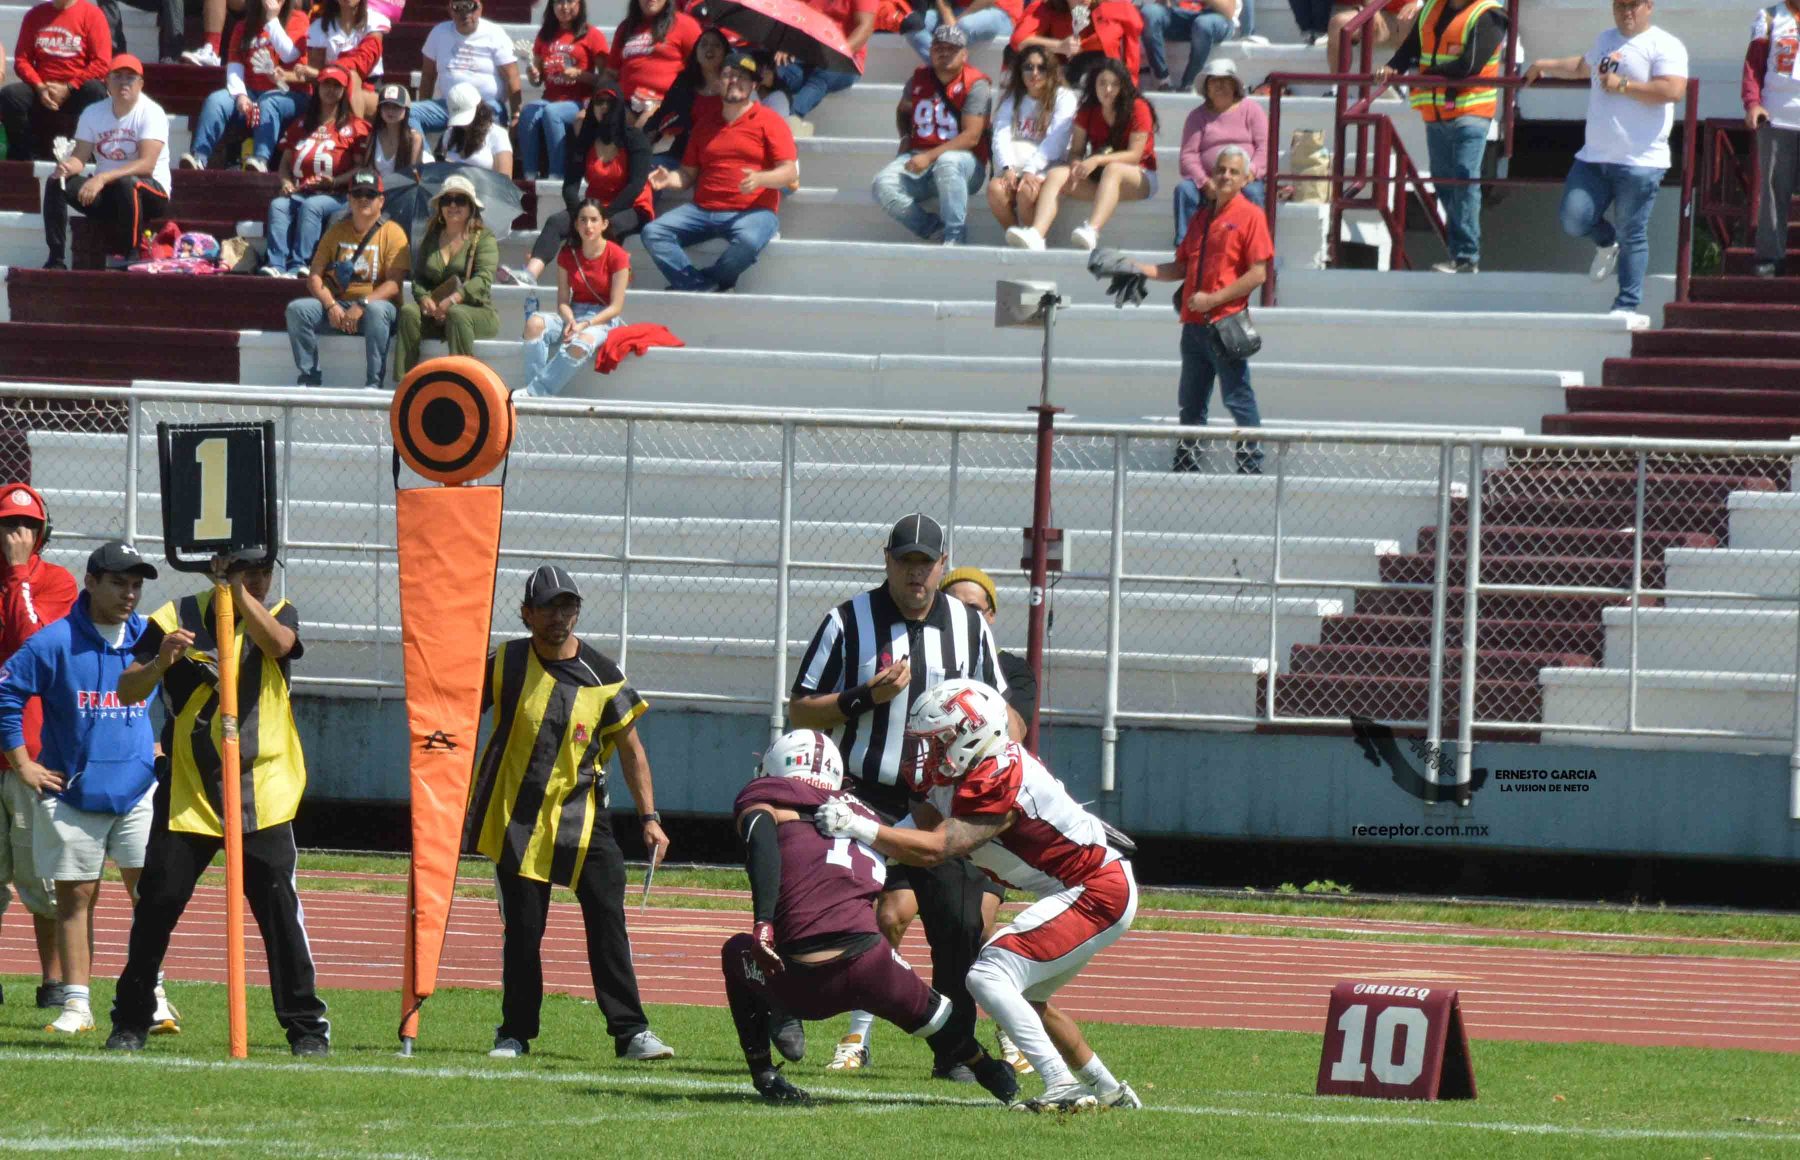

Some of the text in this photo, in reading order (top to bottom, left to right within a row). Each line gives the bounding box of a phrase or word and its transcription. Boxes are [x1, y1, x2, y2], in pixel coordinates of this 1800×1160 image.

[194, 437, 233, 541] 1
[80, 710, 144, 720] TPEYAC
[940, 687, 988, 734] T
[1331, 1004, 1429, 1085] 10
